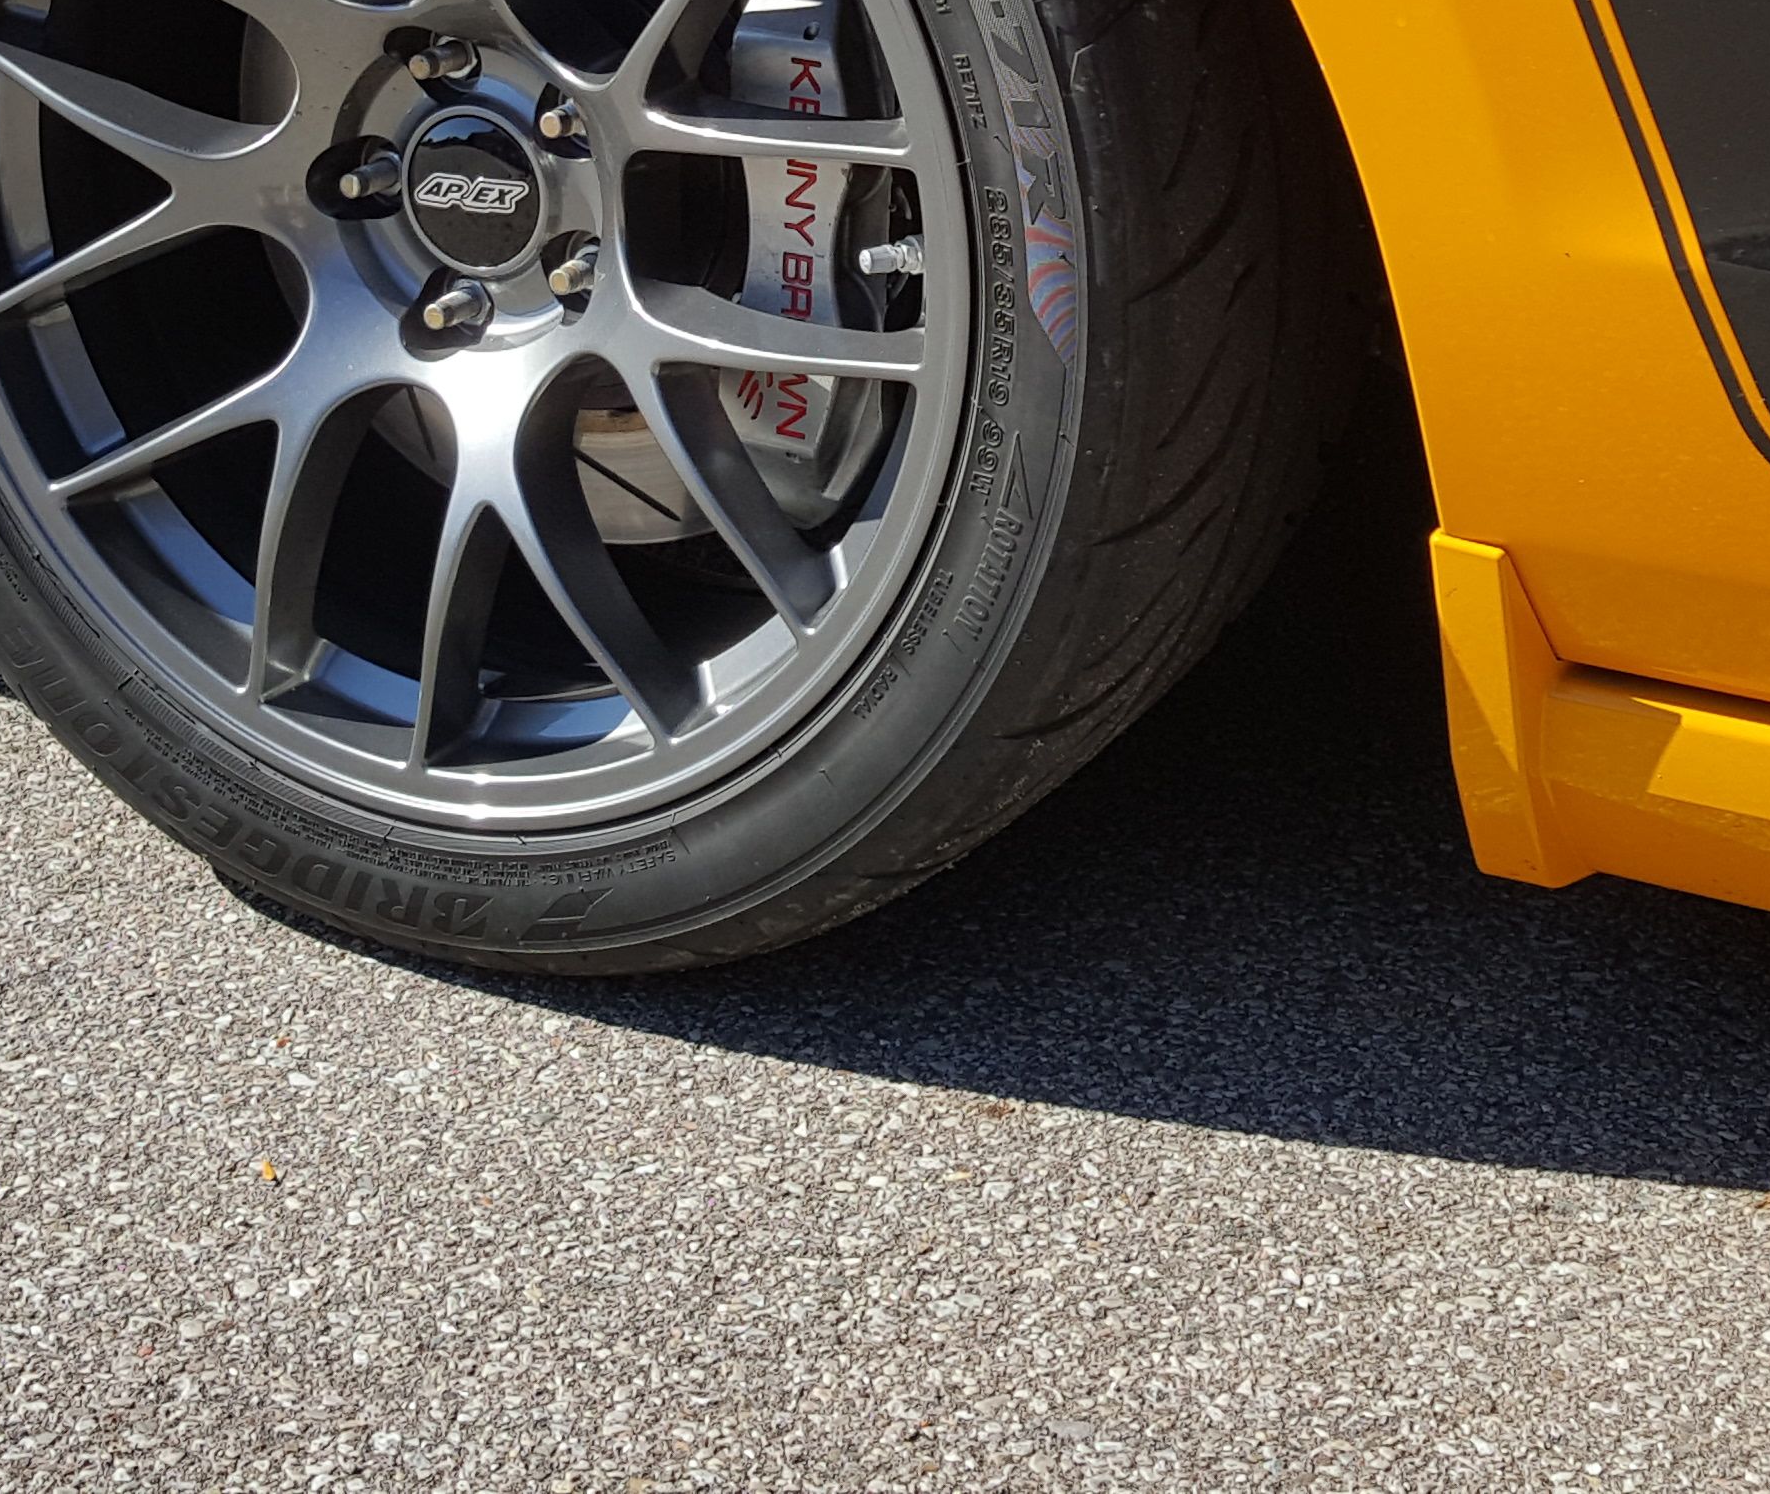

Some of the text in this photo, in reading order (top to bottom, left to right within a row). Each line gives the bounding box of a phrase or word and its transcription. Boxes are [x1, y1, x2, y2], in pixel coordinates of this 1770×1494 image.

[419, 177, 522, 209] APEX
[969, 187, 1014, 501] 285/35R19 99W
[951, 505, 1022, 644] ROTATION
[850, 566, 953, 723] TUBELESS RADIAL
[619, 851, 676, 876] SAFETY
